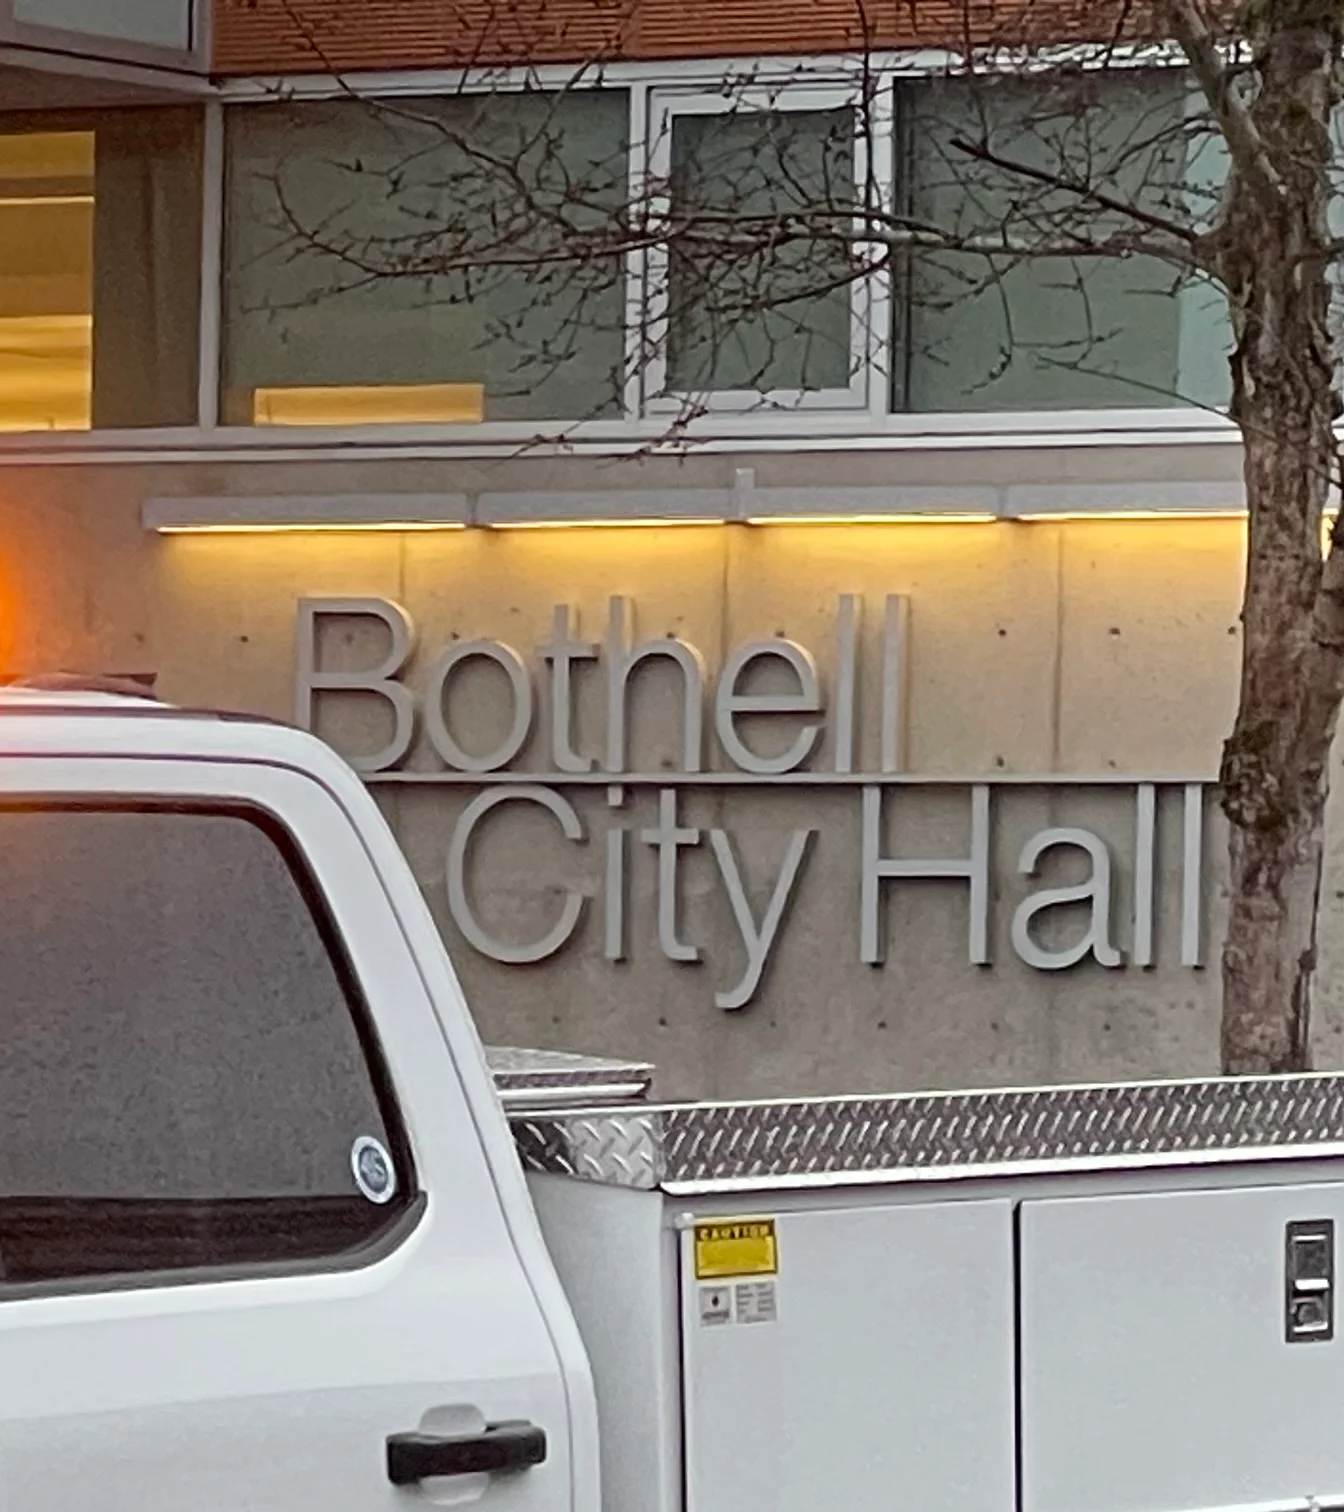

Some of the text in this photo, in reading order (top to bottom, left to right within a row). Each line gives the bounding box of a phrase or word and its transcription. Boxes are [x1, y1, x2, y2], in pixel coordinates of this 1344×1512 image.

[296, 595, 910, 773] Bothell
[447, 784, 1202, 1010] City Hall
